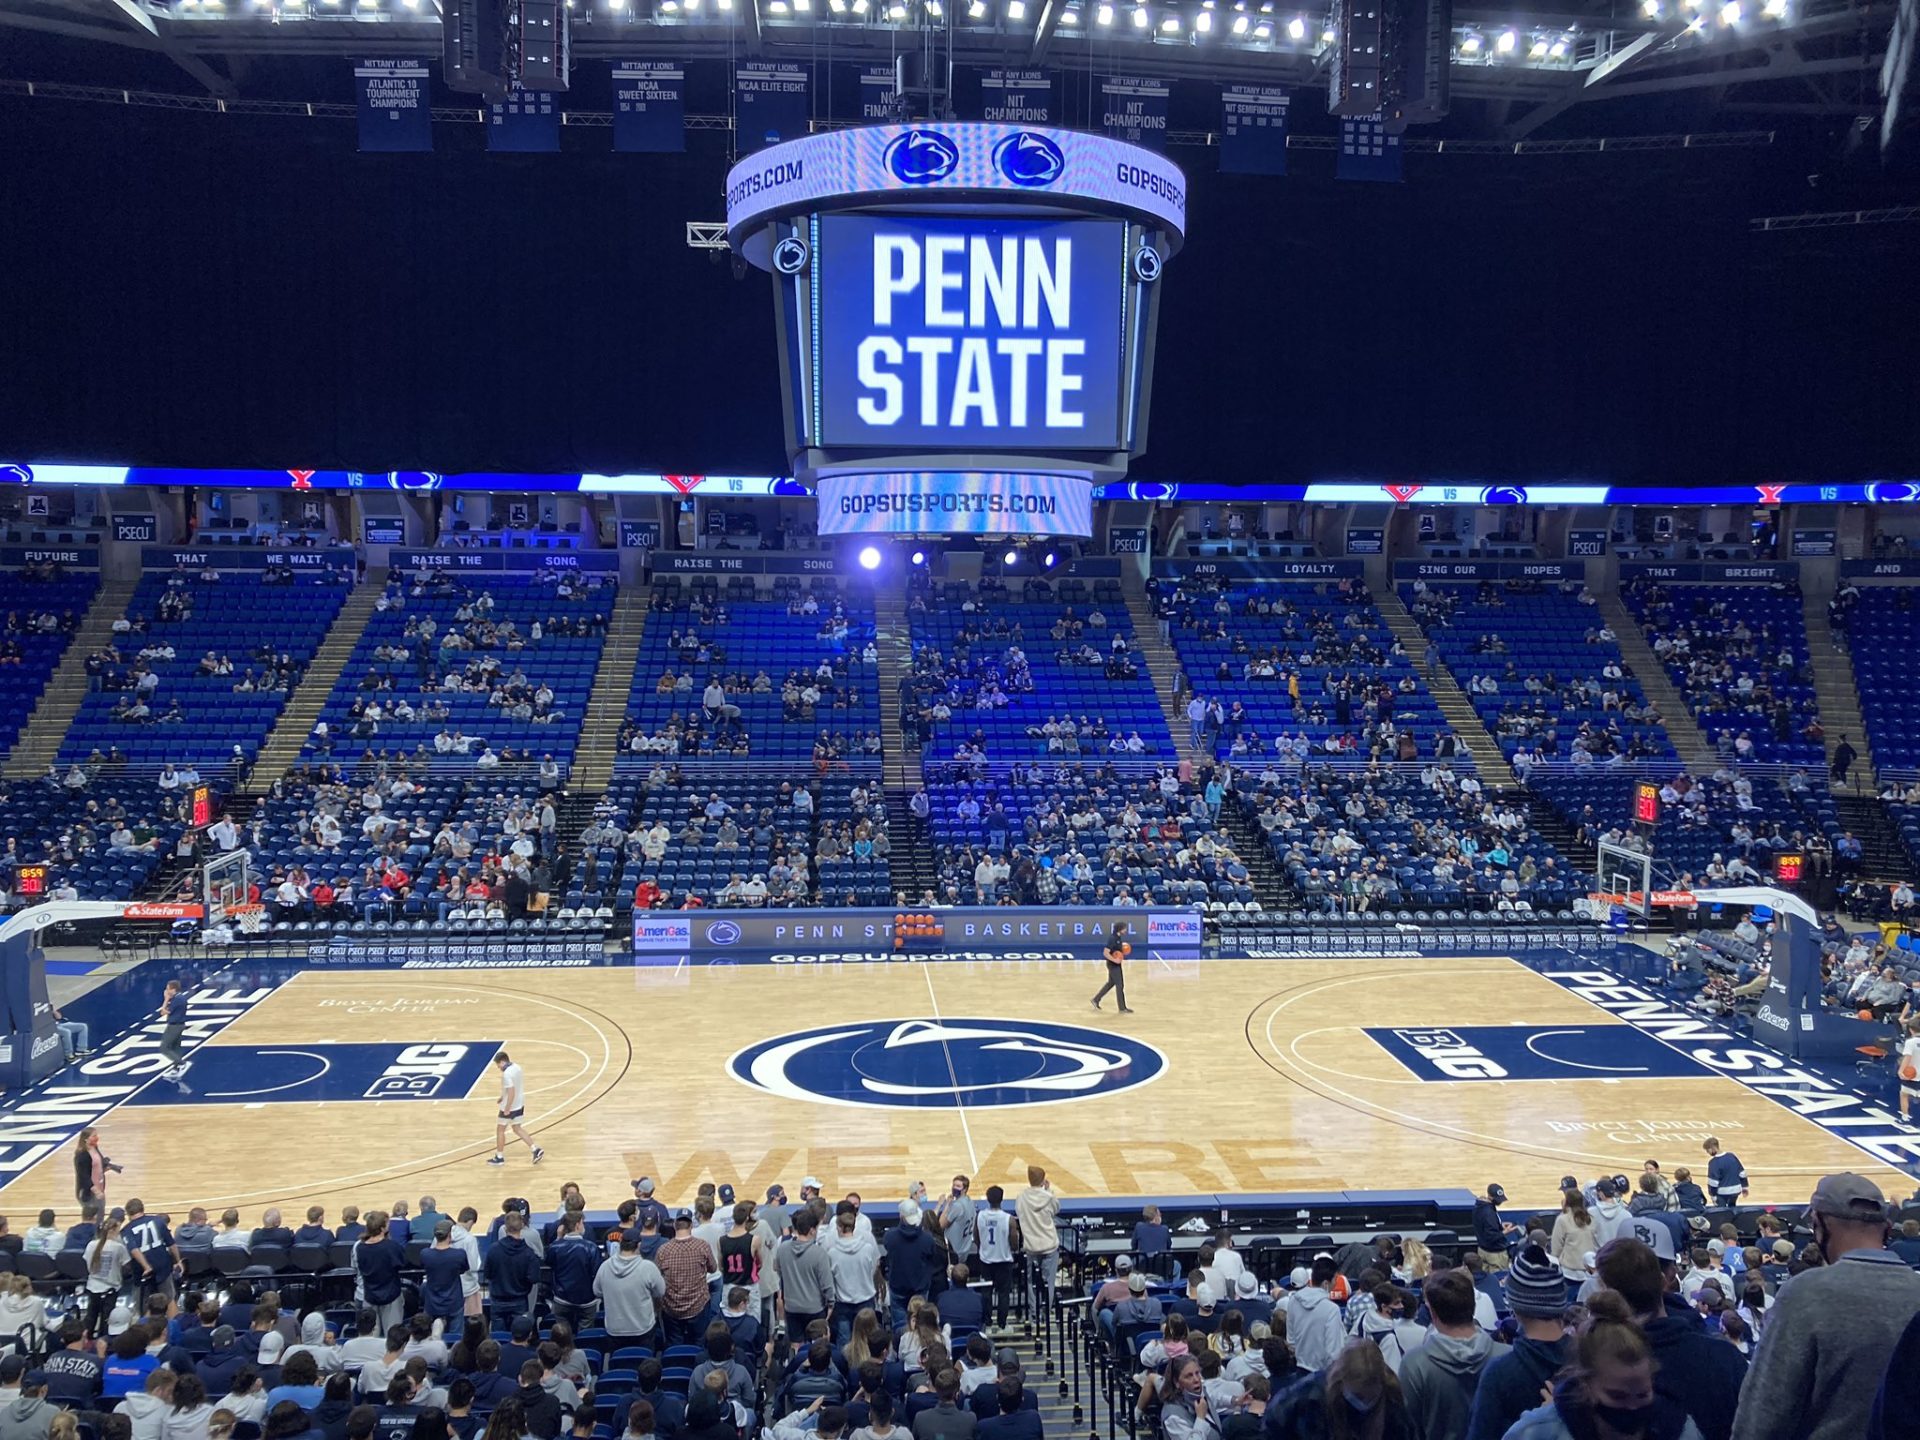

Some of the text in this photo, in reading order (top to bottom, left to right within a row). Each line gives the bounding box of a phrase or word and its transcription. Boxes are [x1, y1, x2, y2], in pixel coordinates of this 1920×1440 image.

[364, 60, 418, 69] NITTANY LIONS
[653, 62, 674, 70] LIONS
[746, 62, 776, 71] NITTANY
[368, 80, 417, 89] ATLANTIC 10
[638, 81, 659, 90] NCAA
[761, 82, 782, 91] ELITE
[783, 83, 805, 92] EIGHT
[366, 89, 420, 98] TOURNAMENT
[618, 90, 677, 100] SWEET SIXTEEN
[1232, 86, 1281, 95] NITTANY LIONS
[370, 98, 417, 108] CHAMPIONS
[1008, 95, 1025, 107] NIT
[1126, 102, 1144, 114] NIT
[1225, 104, 1286, 116] NIT SEMIFINALISTS
[985, 107, 1048, 121] CHAMPIONS
[1104, 113, 1166, 129] CHAMPIONS
[873, 233, 1072, 329] PENN
[857, 336, 1084, 428] STATE
[347, 473, 363, 486] VS
[729, 479, 743, 491] VS
[1444, 489, 1457, 500] VS
[1820, 487, 1837, 500] VS
[841, 494, 1056, 514] GOPSUSPORTS.COM
[119, 526, 149, 540] PSECU
[1115, 539, 1140, 551] PSECU
[1574, 542, 1600, 554] PSECU
[25, 551, 78, 562] FUTURE
[174, 554, 207, 563] THAT
[267, 554, 283, 563] WE
[412, 556, 450, 565] RAISE
[458, 556, 482, 565] THE
[674, 560, 712, 568] RAISE
[720, 560, 743, 568] THE
[1195, 565, 1216, 573] AND
[1874, 565, 1900, 573] AND
[1419, 565, 1561, 575] SING OUR HOPES
[1647, 568, 1776, 577] THAT BRIGHT
[1782, 857, 1800, 865] 8:59
[21, 868, 43, 878] 8:59
[776, 926, 843, 938] PENN
[770, 952, 1074, 963] GoPSUsports.com
[402, 960, 591, 968] BlaiseAlexander.com
[318, 998, 480, 1008] BRYCE JORDAN
[1542, 971, 1734, 1041] PENN
[80, 987, 273, 1076] STATE
[1546, 1119, 1744, 1133] BRYCE JORDAN
[1607, 1131, 1720, 1144] CENTER
[621, 1141, 1350, 1200] WE ARE
[131, 1220, 162, 1253] 71
[989, 1227, 995, 1245] 1
[727, 1254, 743, 1272] 11
